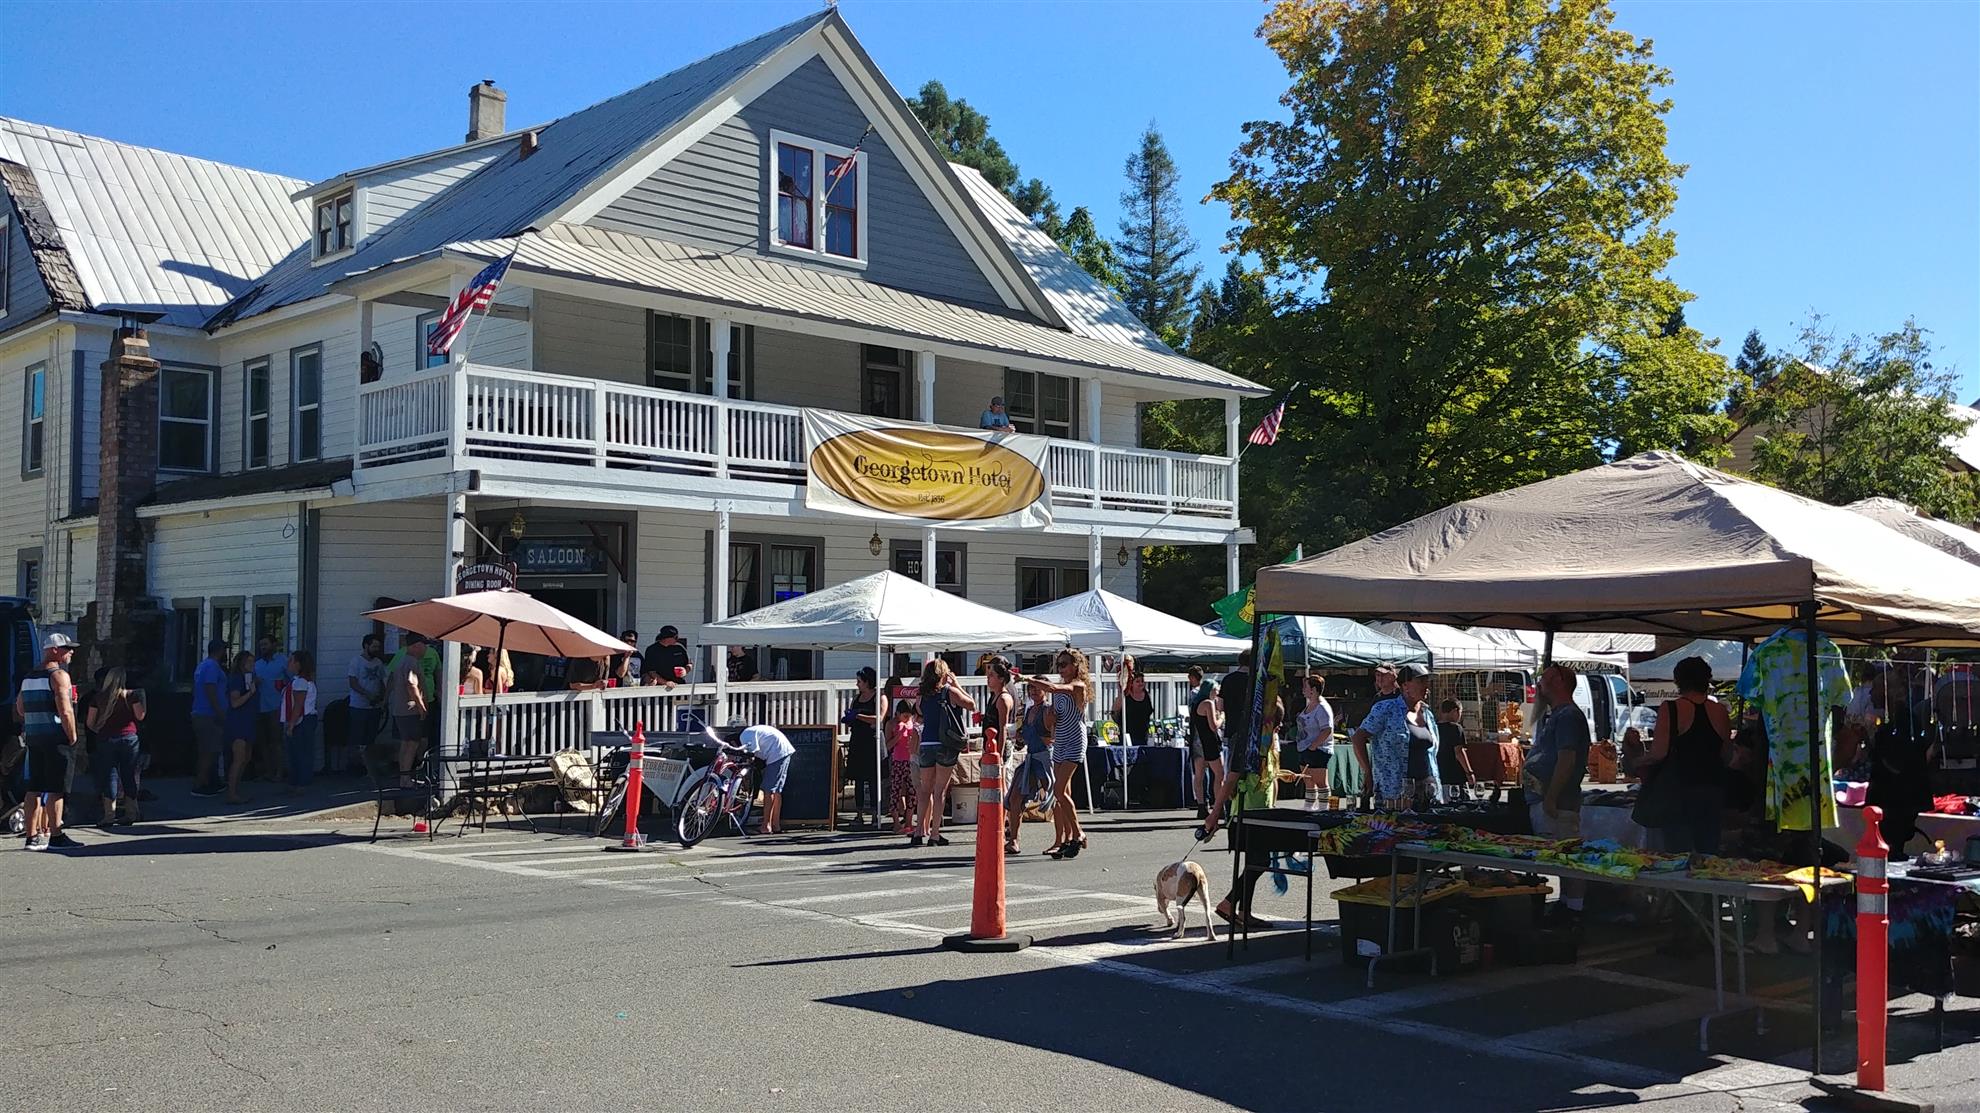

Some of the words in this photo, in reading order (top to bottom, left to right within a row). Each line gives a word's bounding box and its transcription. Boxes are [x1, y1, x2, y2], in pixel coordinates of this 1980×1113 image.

[852, 454, 964, 486] Georgetown
[969, 461, 1012, 489] Hotel
[528, 548, 585, 564] SALOON
[494, 565, 513, 584] HOTEL
[464, 580, 485, 589] DINING
[486, 579, 502, 589] ROOM
